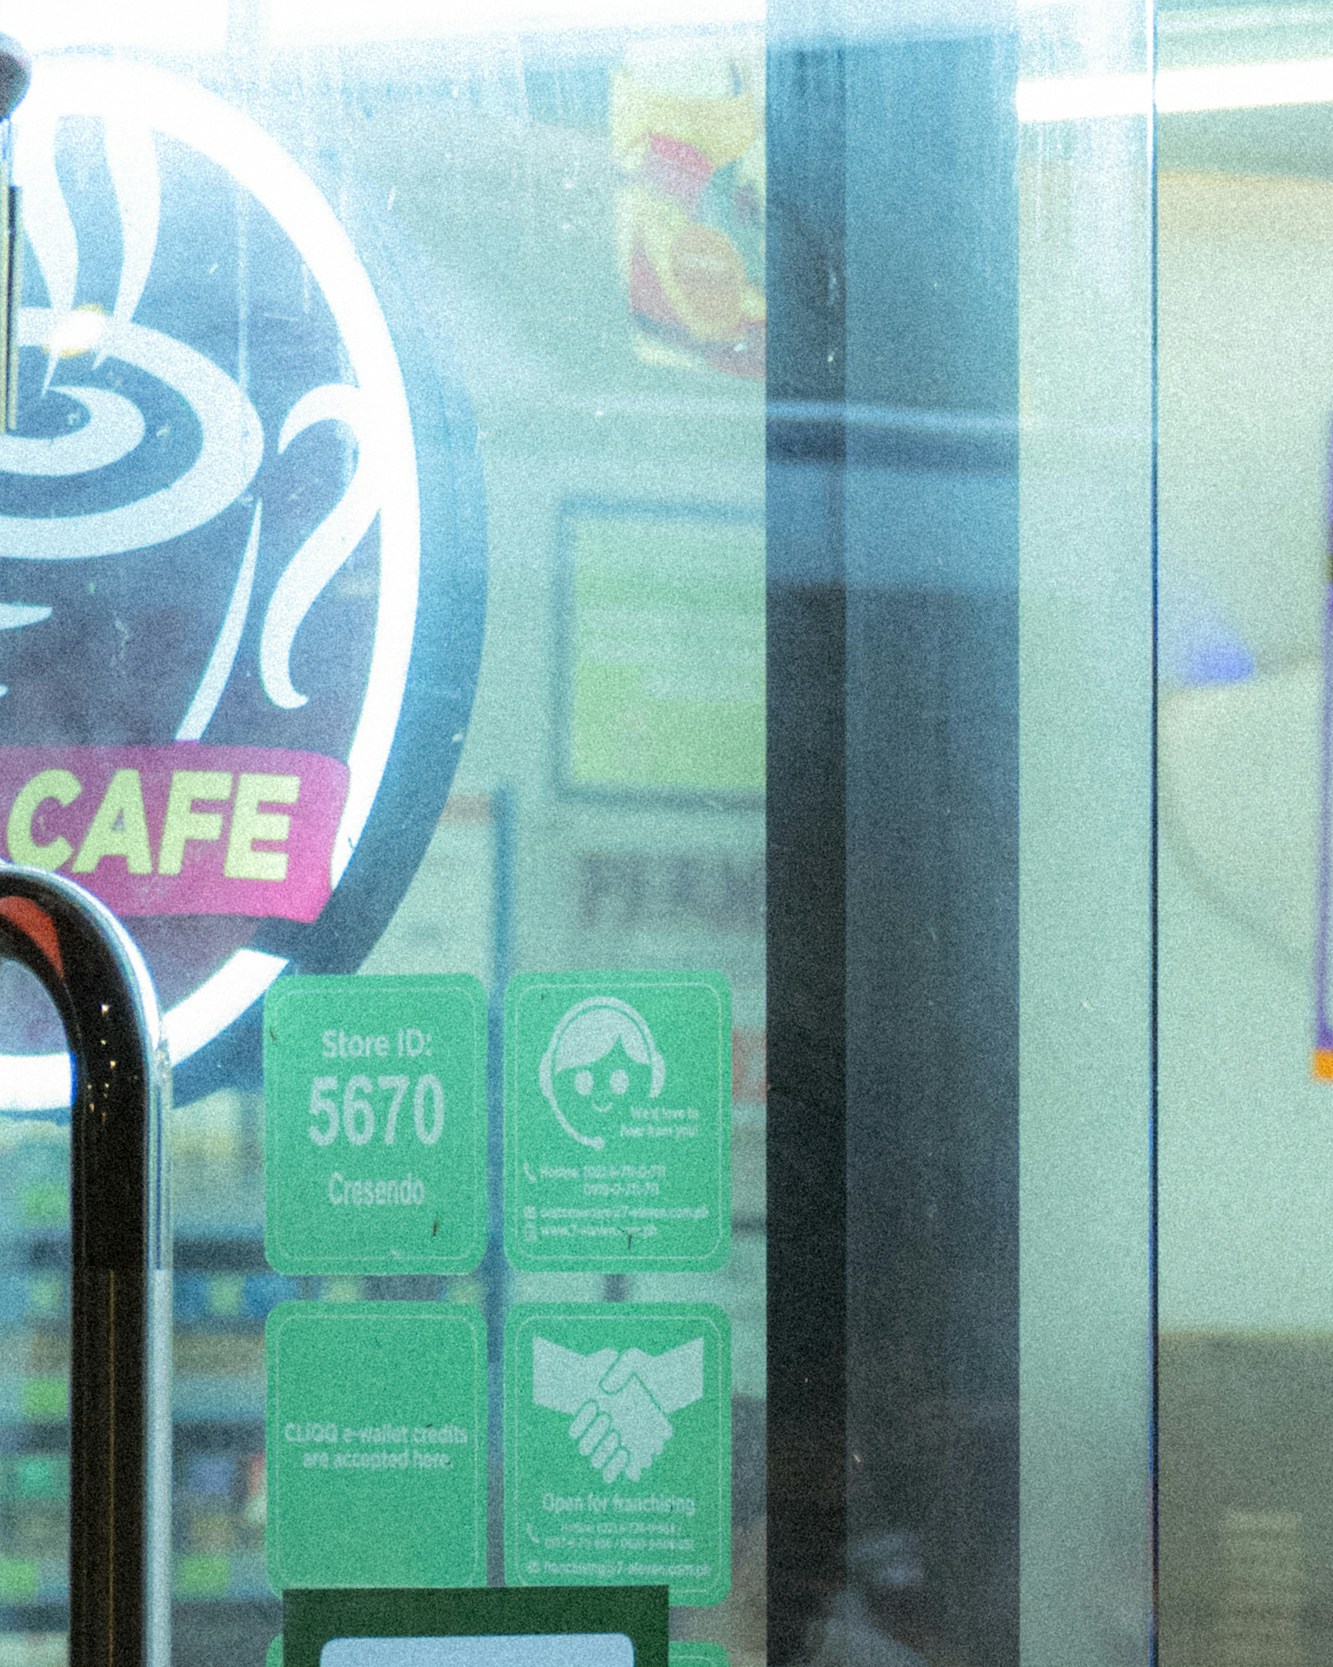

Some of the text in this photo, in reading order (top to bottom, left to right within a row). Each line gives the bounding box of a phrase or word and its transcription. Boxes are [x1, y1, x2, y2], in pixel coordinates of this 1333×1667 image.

[7, 768, 300, 881] CAFE
[322, 1026, 432, 1058] Store ID:
[308, 1072, 445, 1147] 5670
